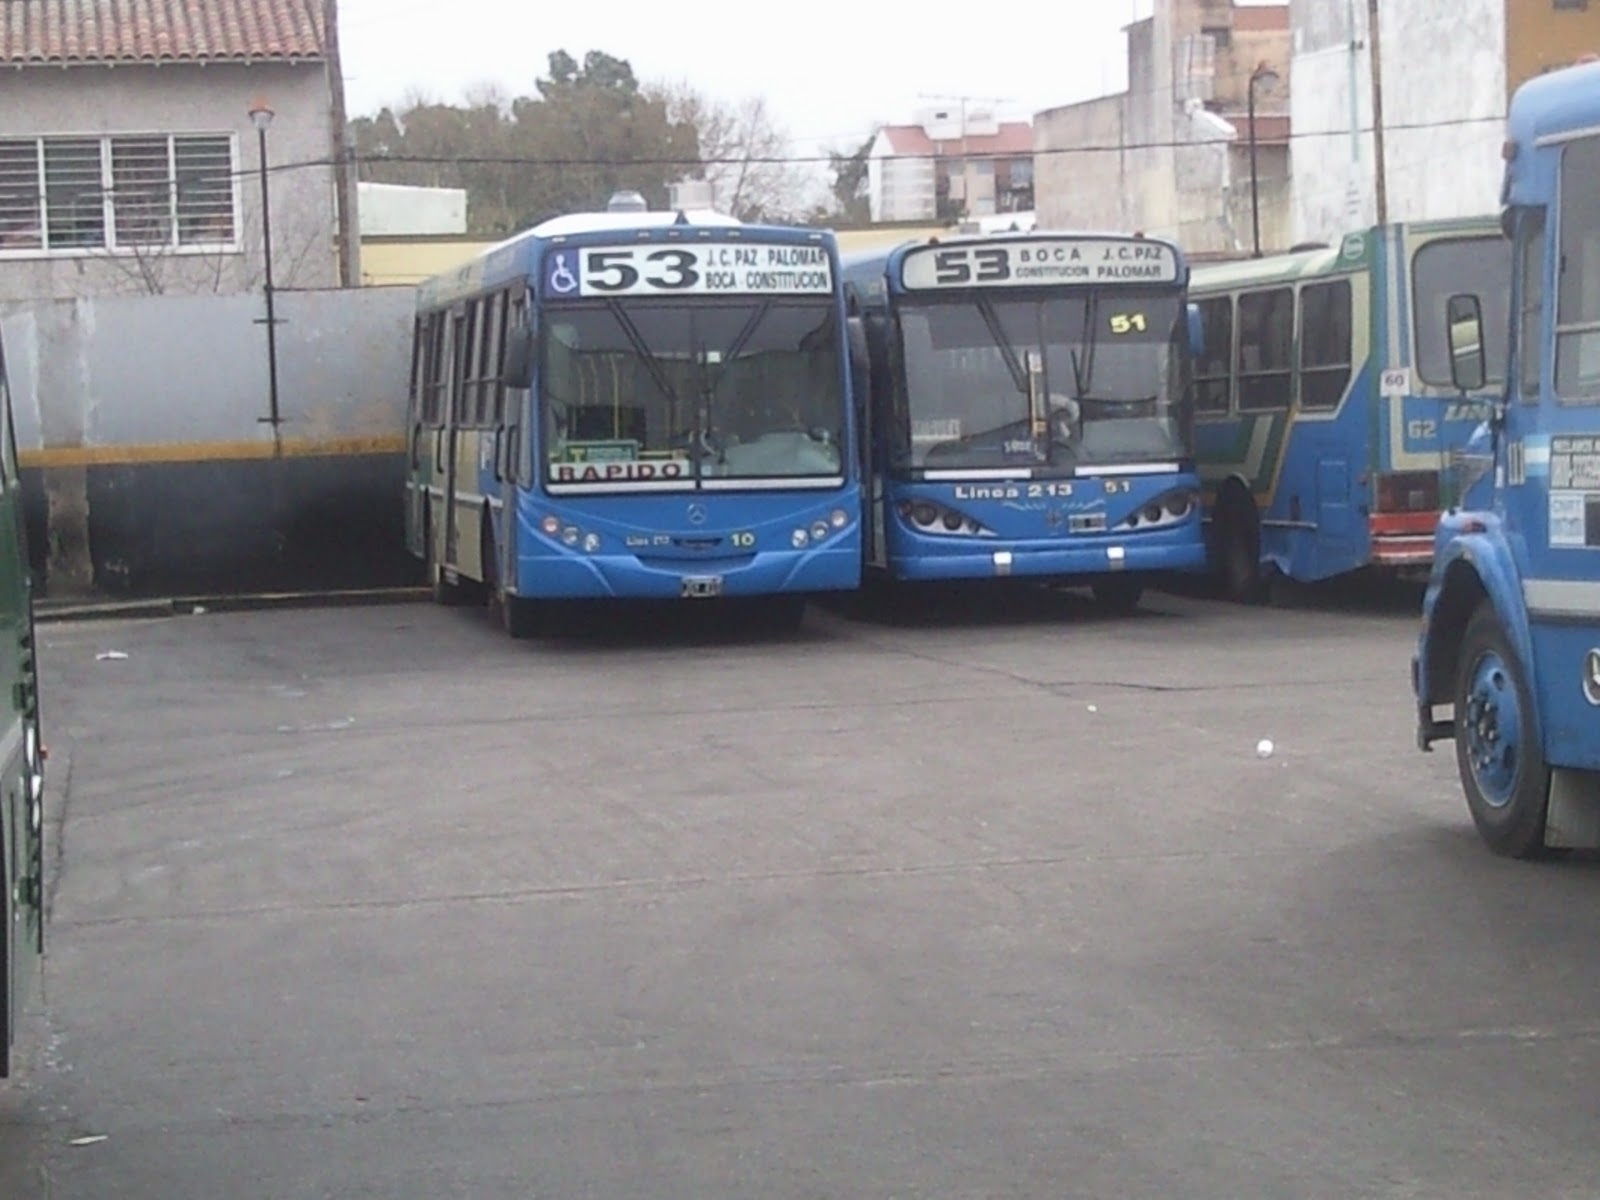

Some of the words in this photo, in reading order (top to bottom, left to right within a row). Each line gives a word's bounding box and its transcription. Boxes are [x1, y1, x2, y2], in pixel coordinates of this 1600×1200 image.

[735, 249, 758, 266] PAZ
[768, 249, 826, 266] PALOMAR
[1020, 247, 1081, 262] BOCA
[586, 250, 700, 291] 53
[934, 248, 1010, 284] 53
[1015, 265, 1090, 279] CONSTITUCION
[1098, 265, 1162, 278] PALOMAR
[705, 271, 736, 289] BOCA
[746, 271, 828, 289] CONSTITUCION
[1110, 313, 1146, 334] 51
[1385, 373, 1404, 387] 60
[558, 463, 681, 480] RAPIDO
[955, 485, 1019, 499] Linea
[1027, 482, 1074, 497] 213
[731, 532, 755, 547] 10
